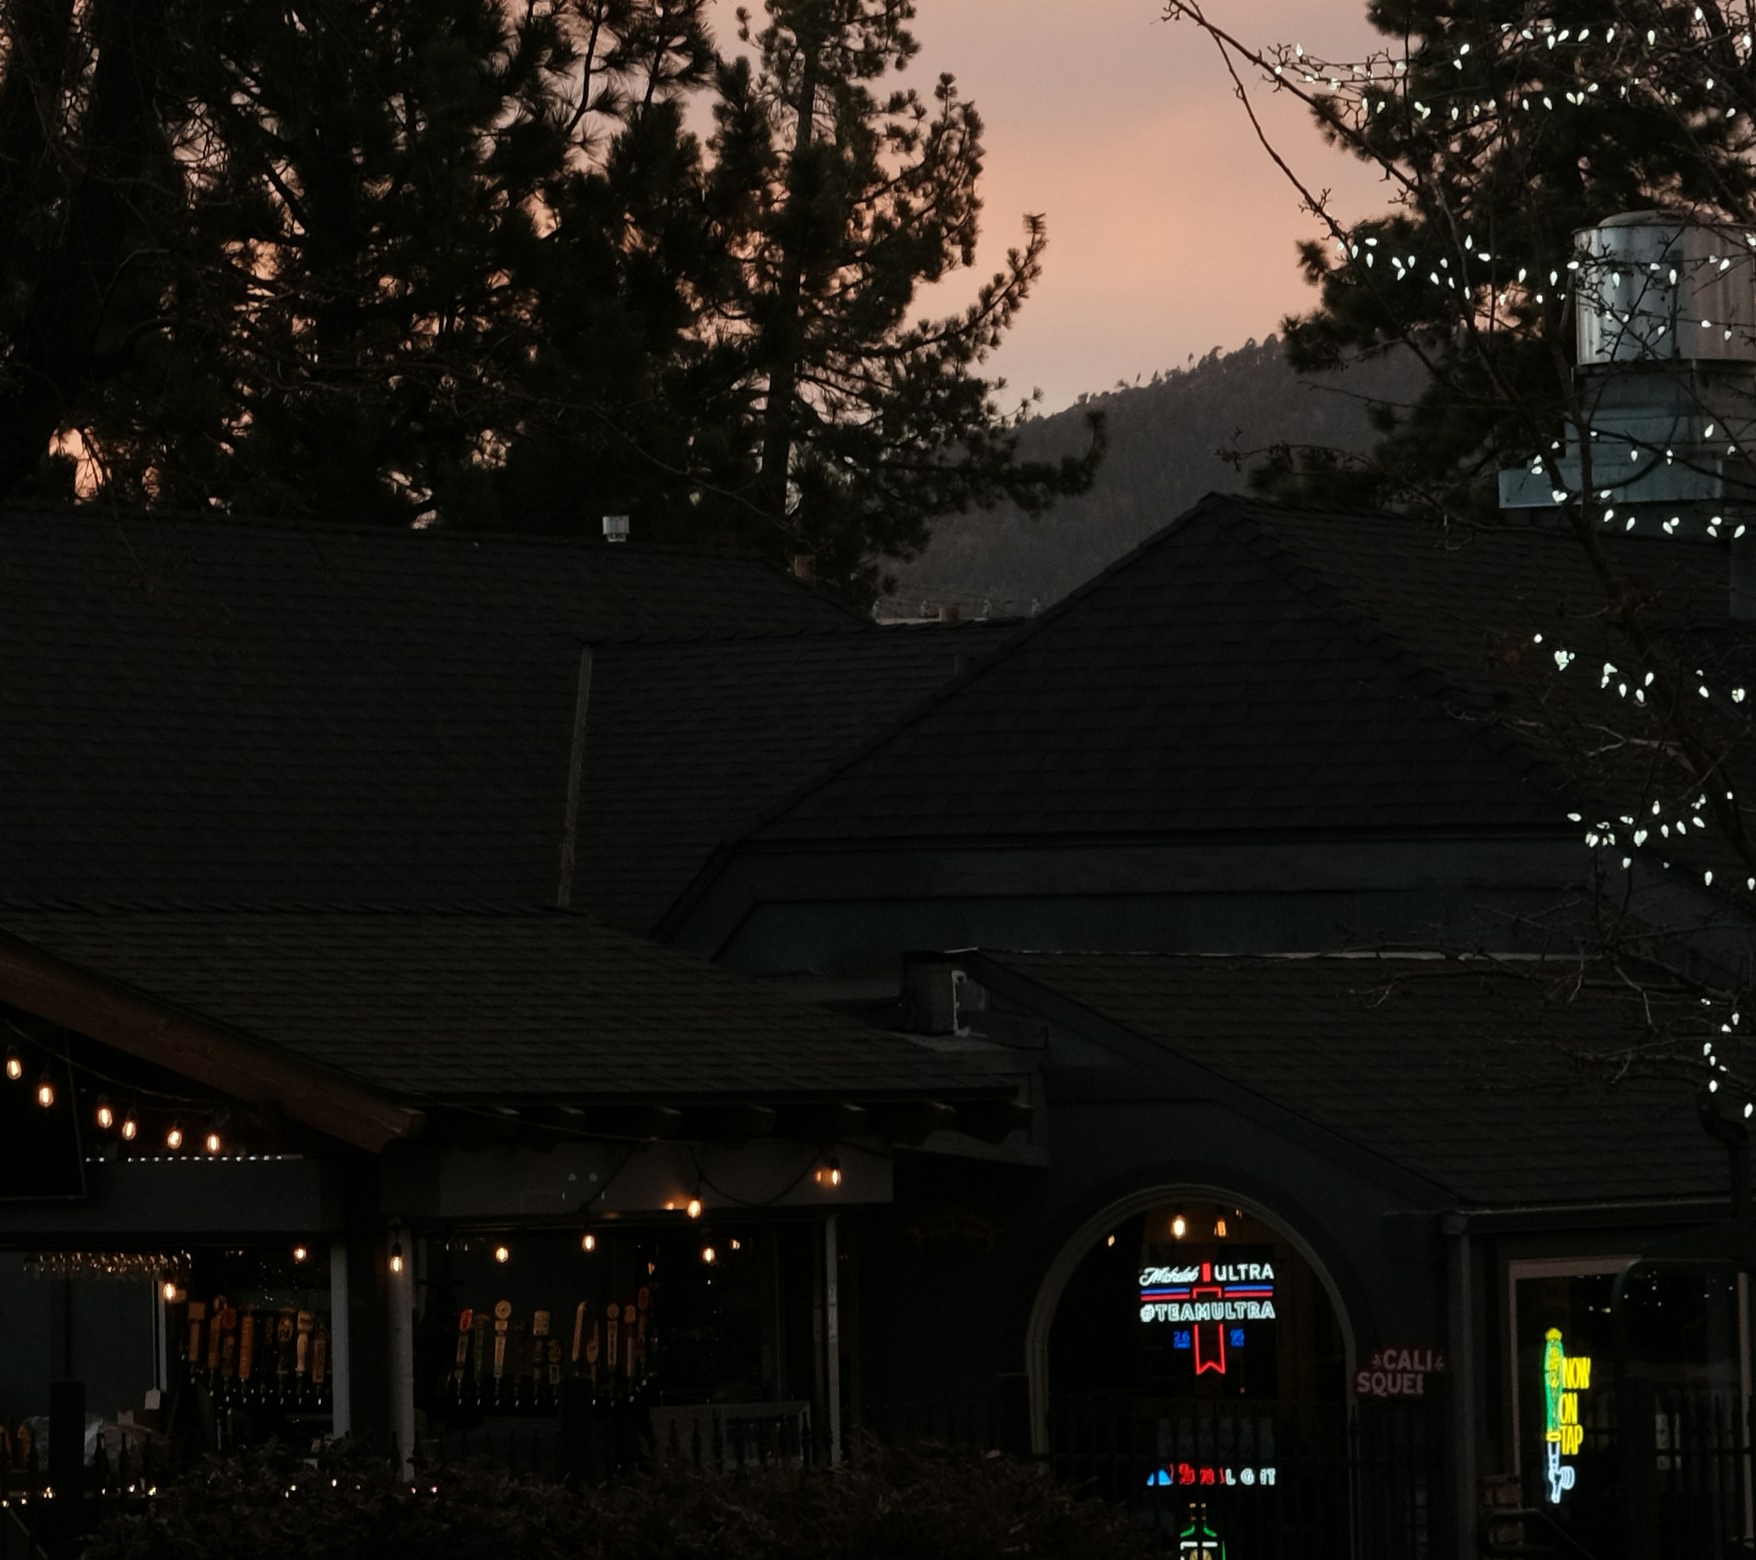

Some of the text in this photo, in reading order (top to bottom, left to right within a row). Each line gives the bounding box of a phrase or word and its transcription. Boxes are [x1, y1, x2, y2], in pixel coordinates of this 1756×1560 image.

[1214, 1262, 1275, 1282] ULTRA
[1382, 1347, 1434, 1372] CALI
[1562, 1356, 1592, 1390] NOW
[1559, 1392, 1578, 1425] ON
[1559, 1424, 1584, 1455] TAP
